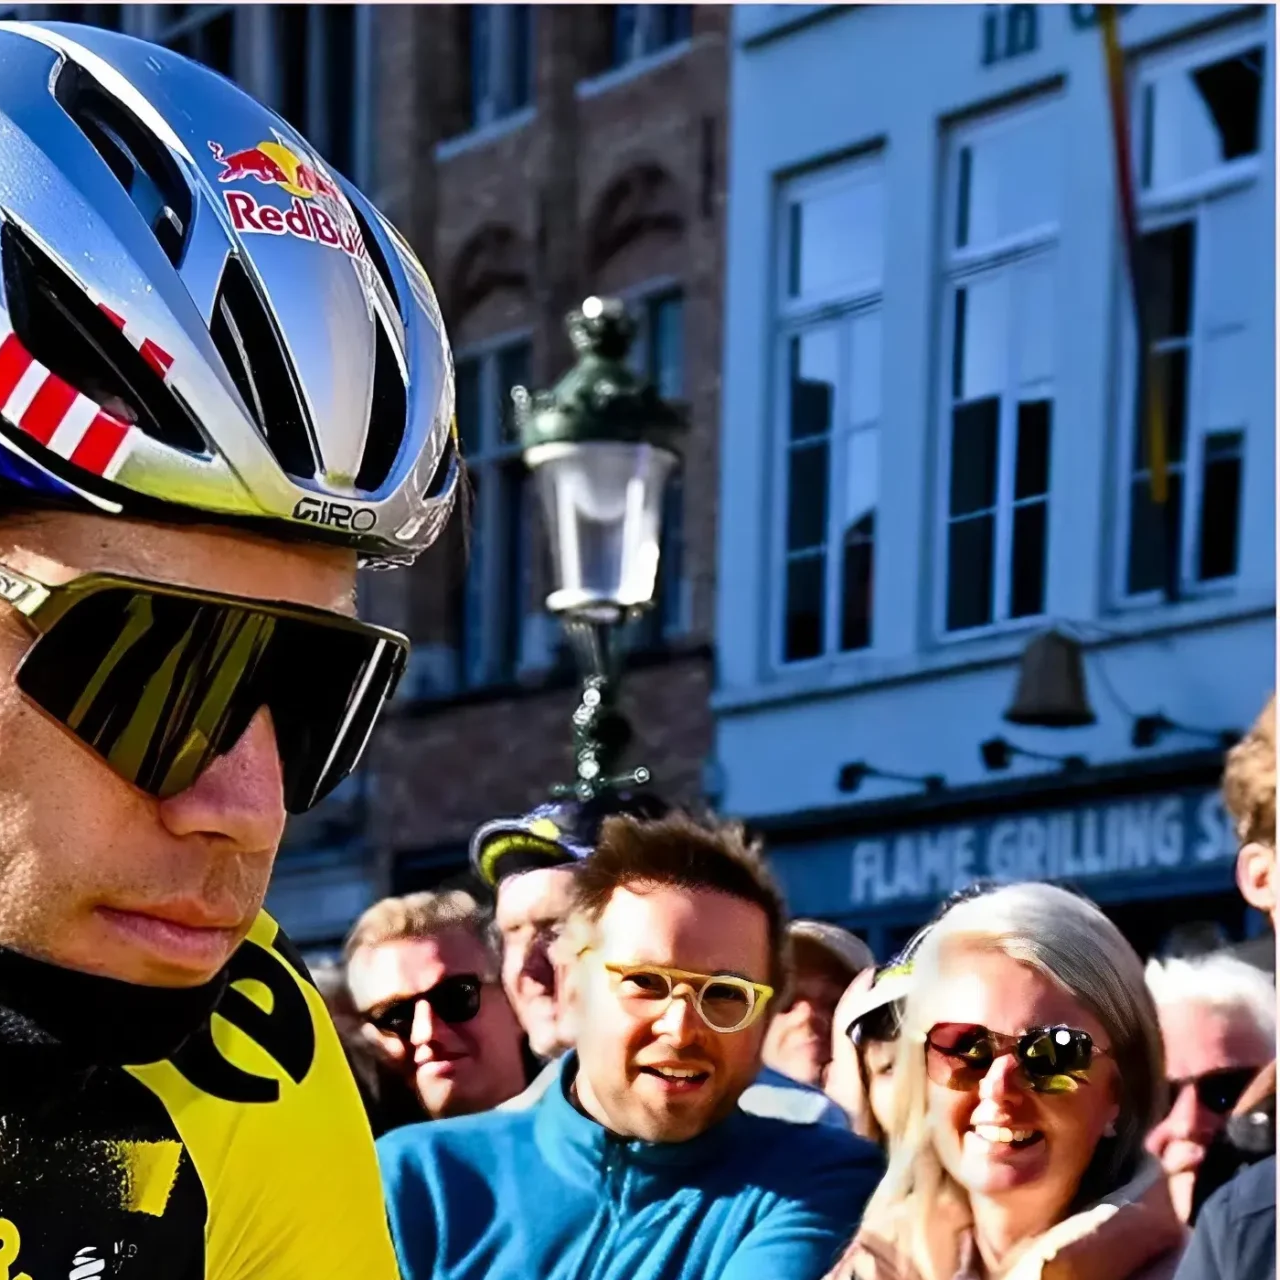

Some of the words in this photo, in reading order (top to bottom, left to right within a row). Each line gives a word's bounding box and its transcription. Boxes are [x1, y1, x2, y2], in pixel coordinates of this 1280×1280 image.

[292, 497, 377, 532] GIRO
[851, 834, 976, 903] FLAME
[988, 797, 1184, 880] GRILLING
